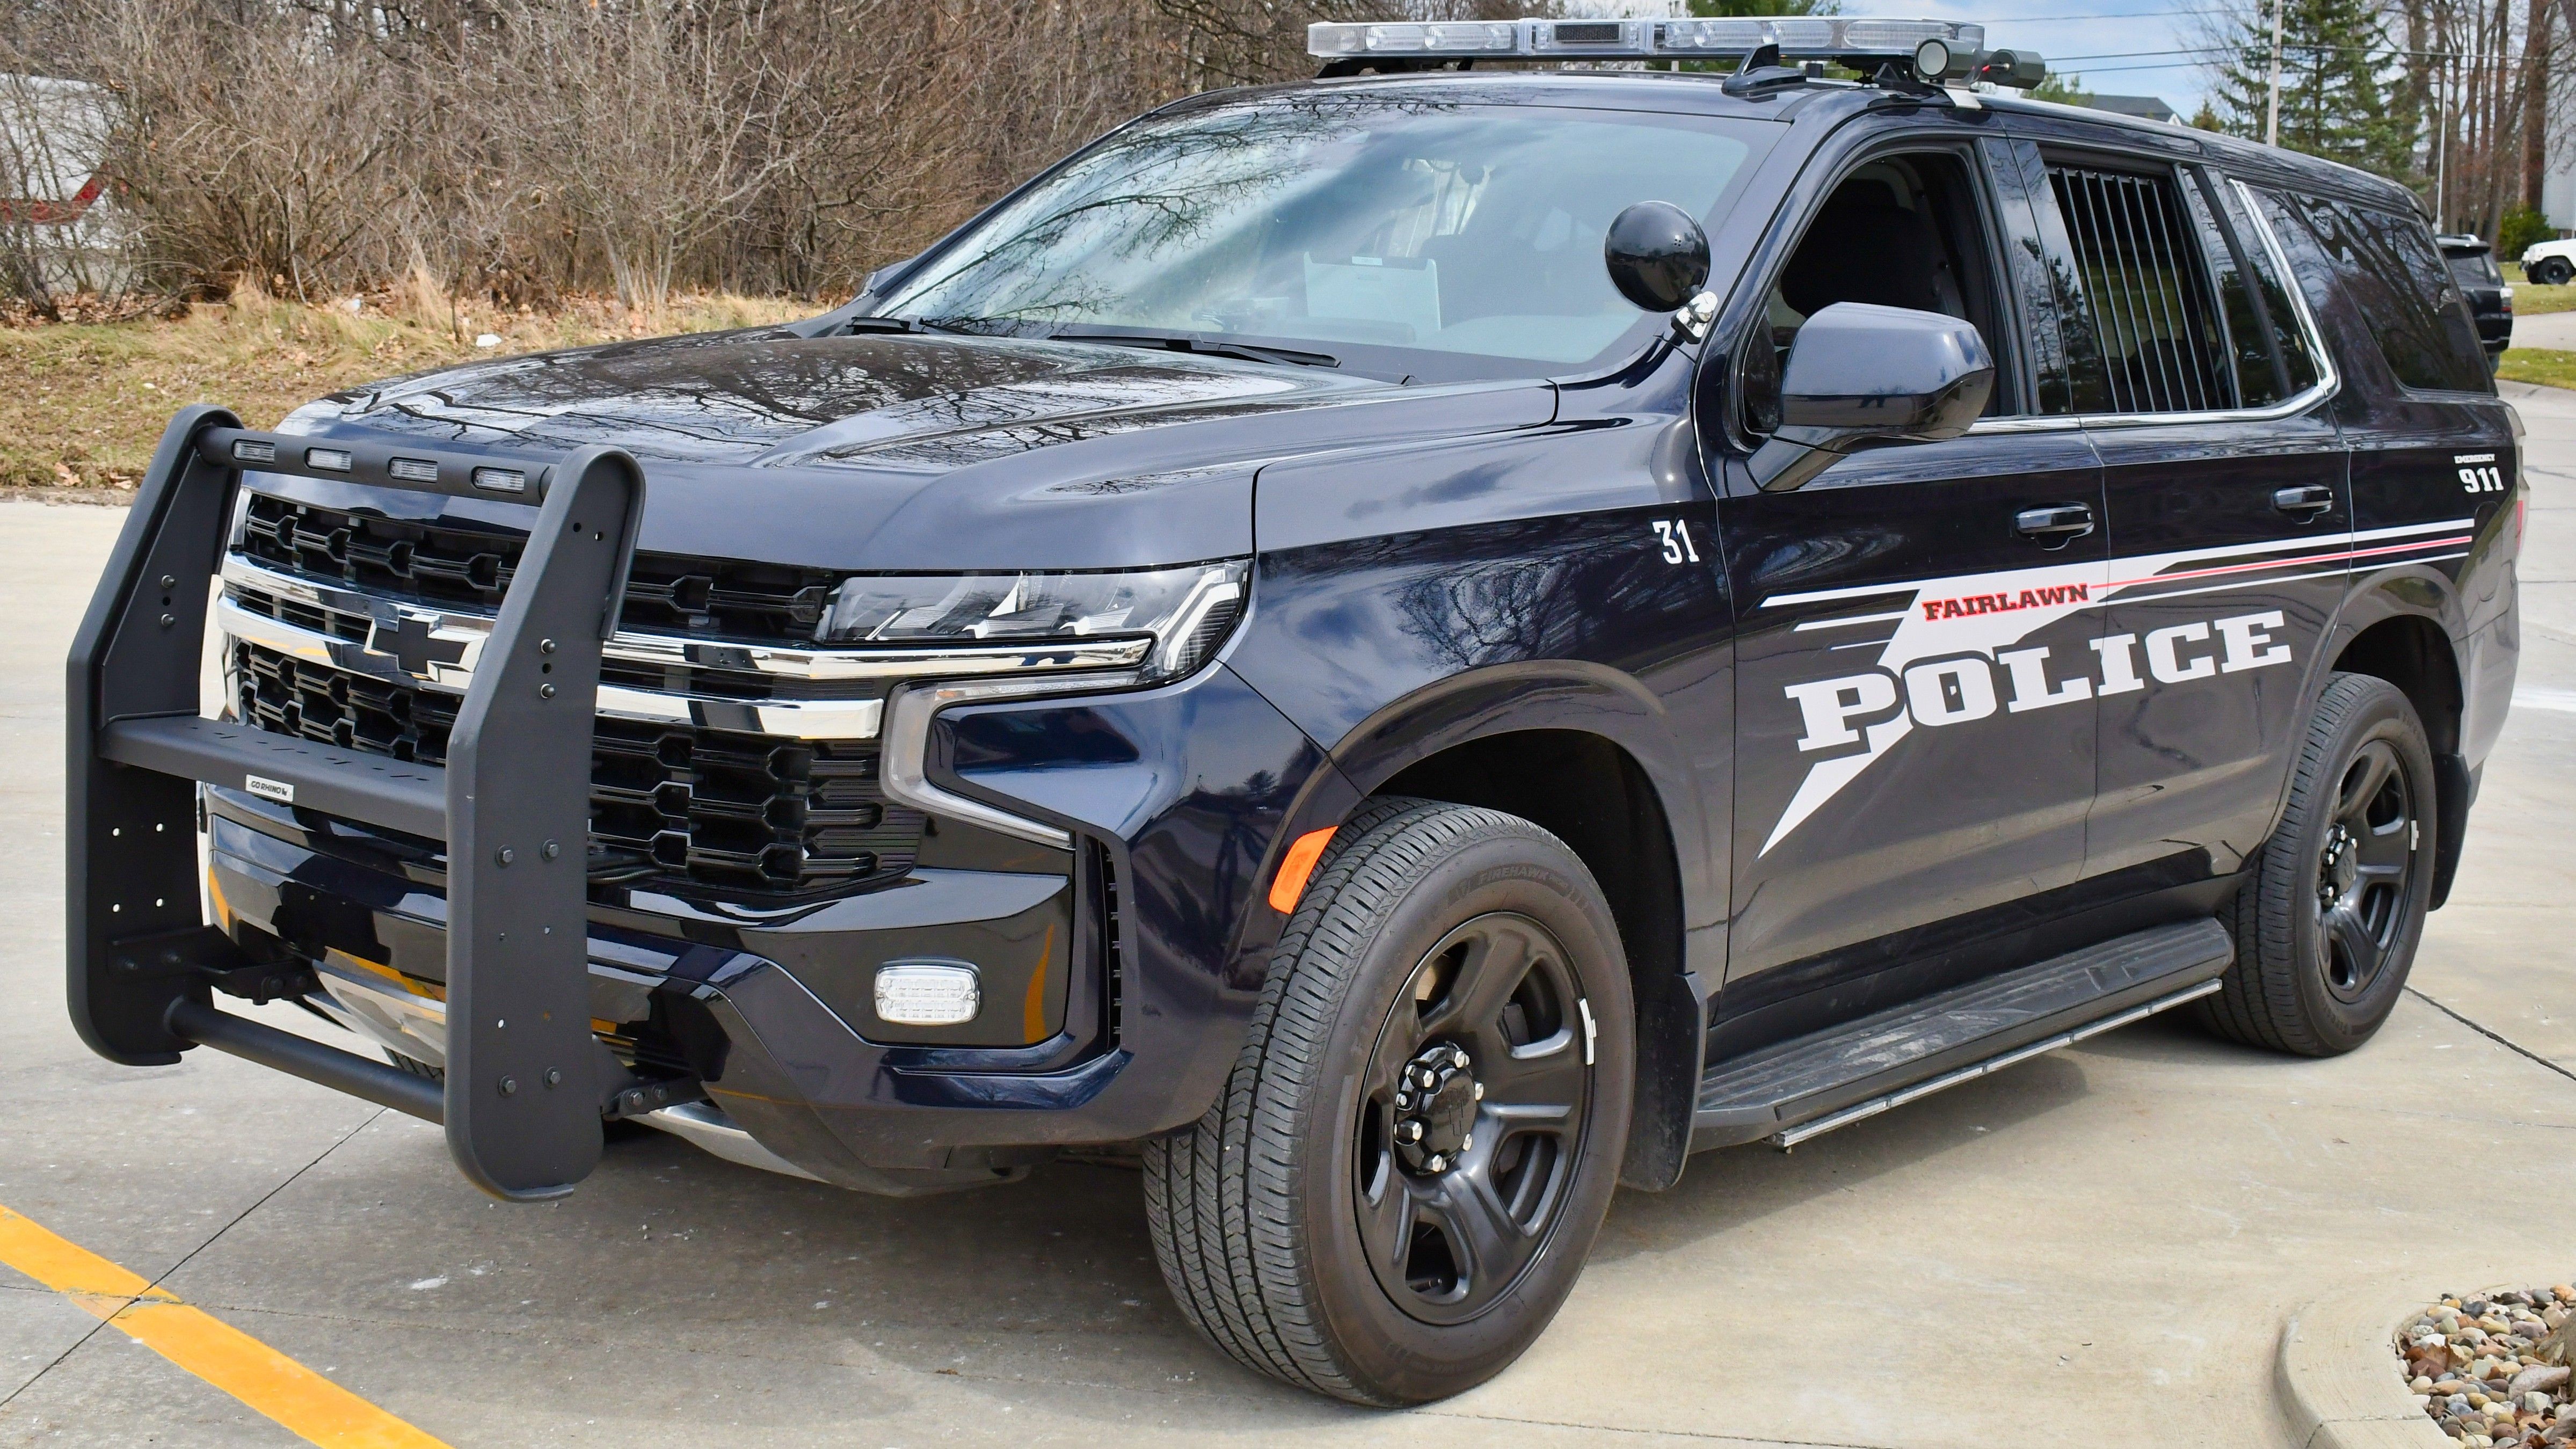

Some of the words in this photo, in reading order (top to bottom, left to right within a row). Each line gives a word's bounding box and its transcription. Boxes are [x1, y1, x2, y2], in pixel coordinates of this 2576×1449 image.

[2458, 467, 2504, 493] 911
[1652, 519, 1700, 564] 31
[1921, 582, 2090, 622] FAIRLAWN
[1784, 610, 2292, 751] POLICE
[251, 781, 260, 789] GO
[260, 783, 281, 793] RHINO
